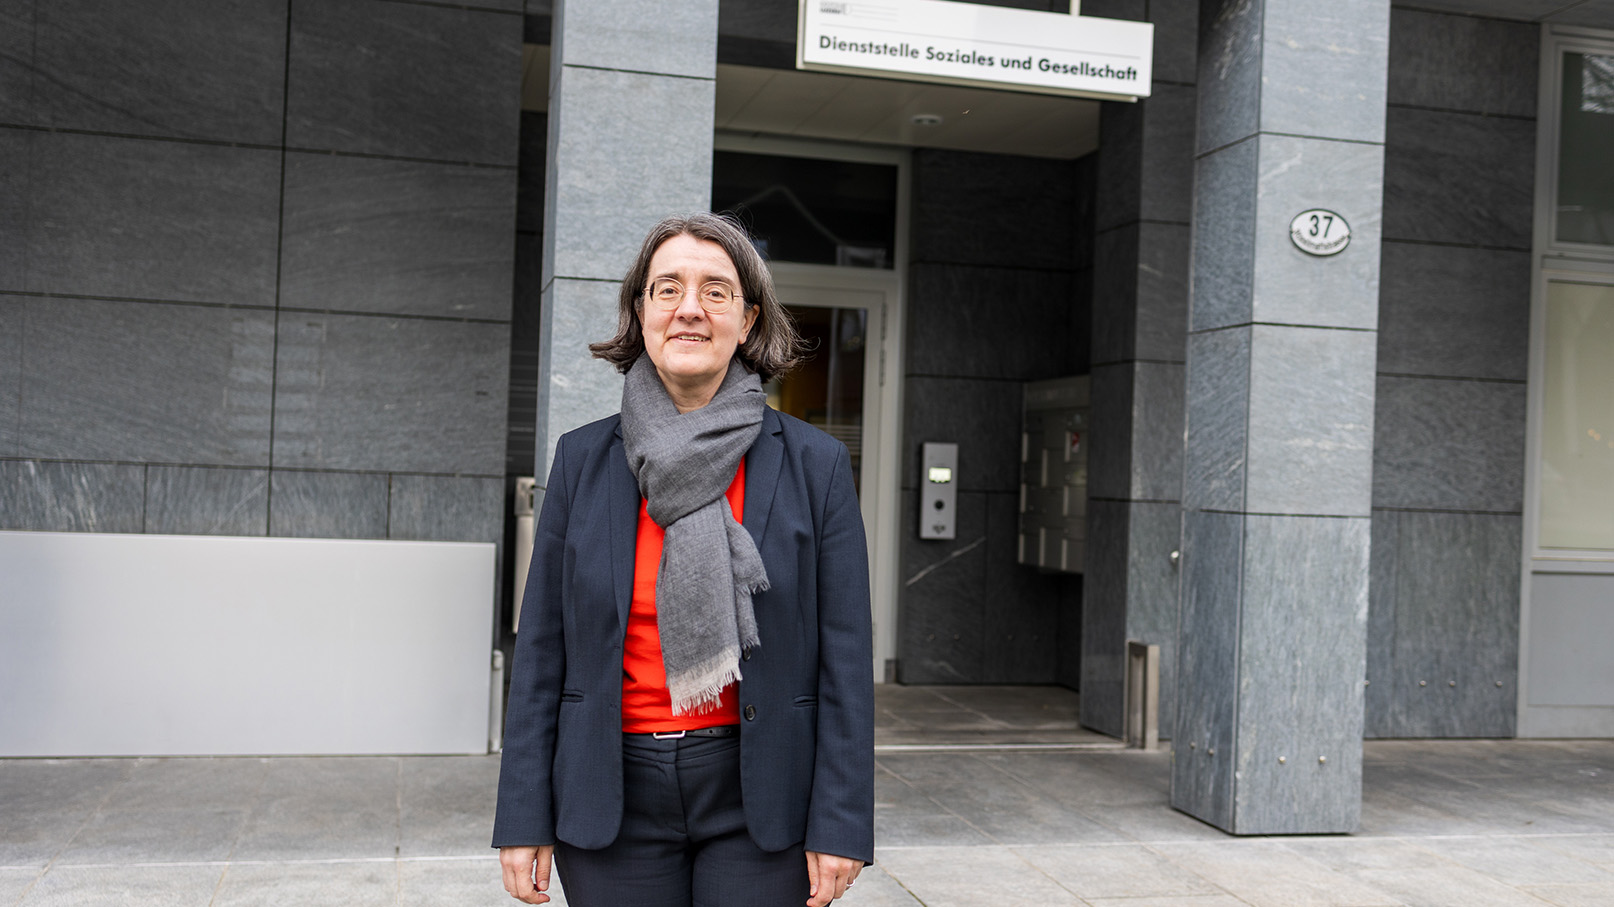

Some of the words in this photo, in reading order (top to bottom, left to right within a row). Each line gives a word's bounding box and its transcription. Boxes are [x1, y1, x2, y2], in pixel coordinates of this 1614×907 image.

[819, 35, 920, 59] Dienststelle
[926, 46, 995, 67] Soziales
[1000, 56, 1033, 70] und
[1038, 58, 1138, 81] Gesellschaft
[1309, 214, 1333, 238] 37
